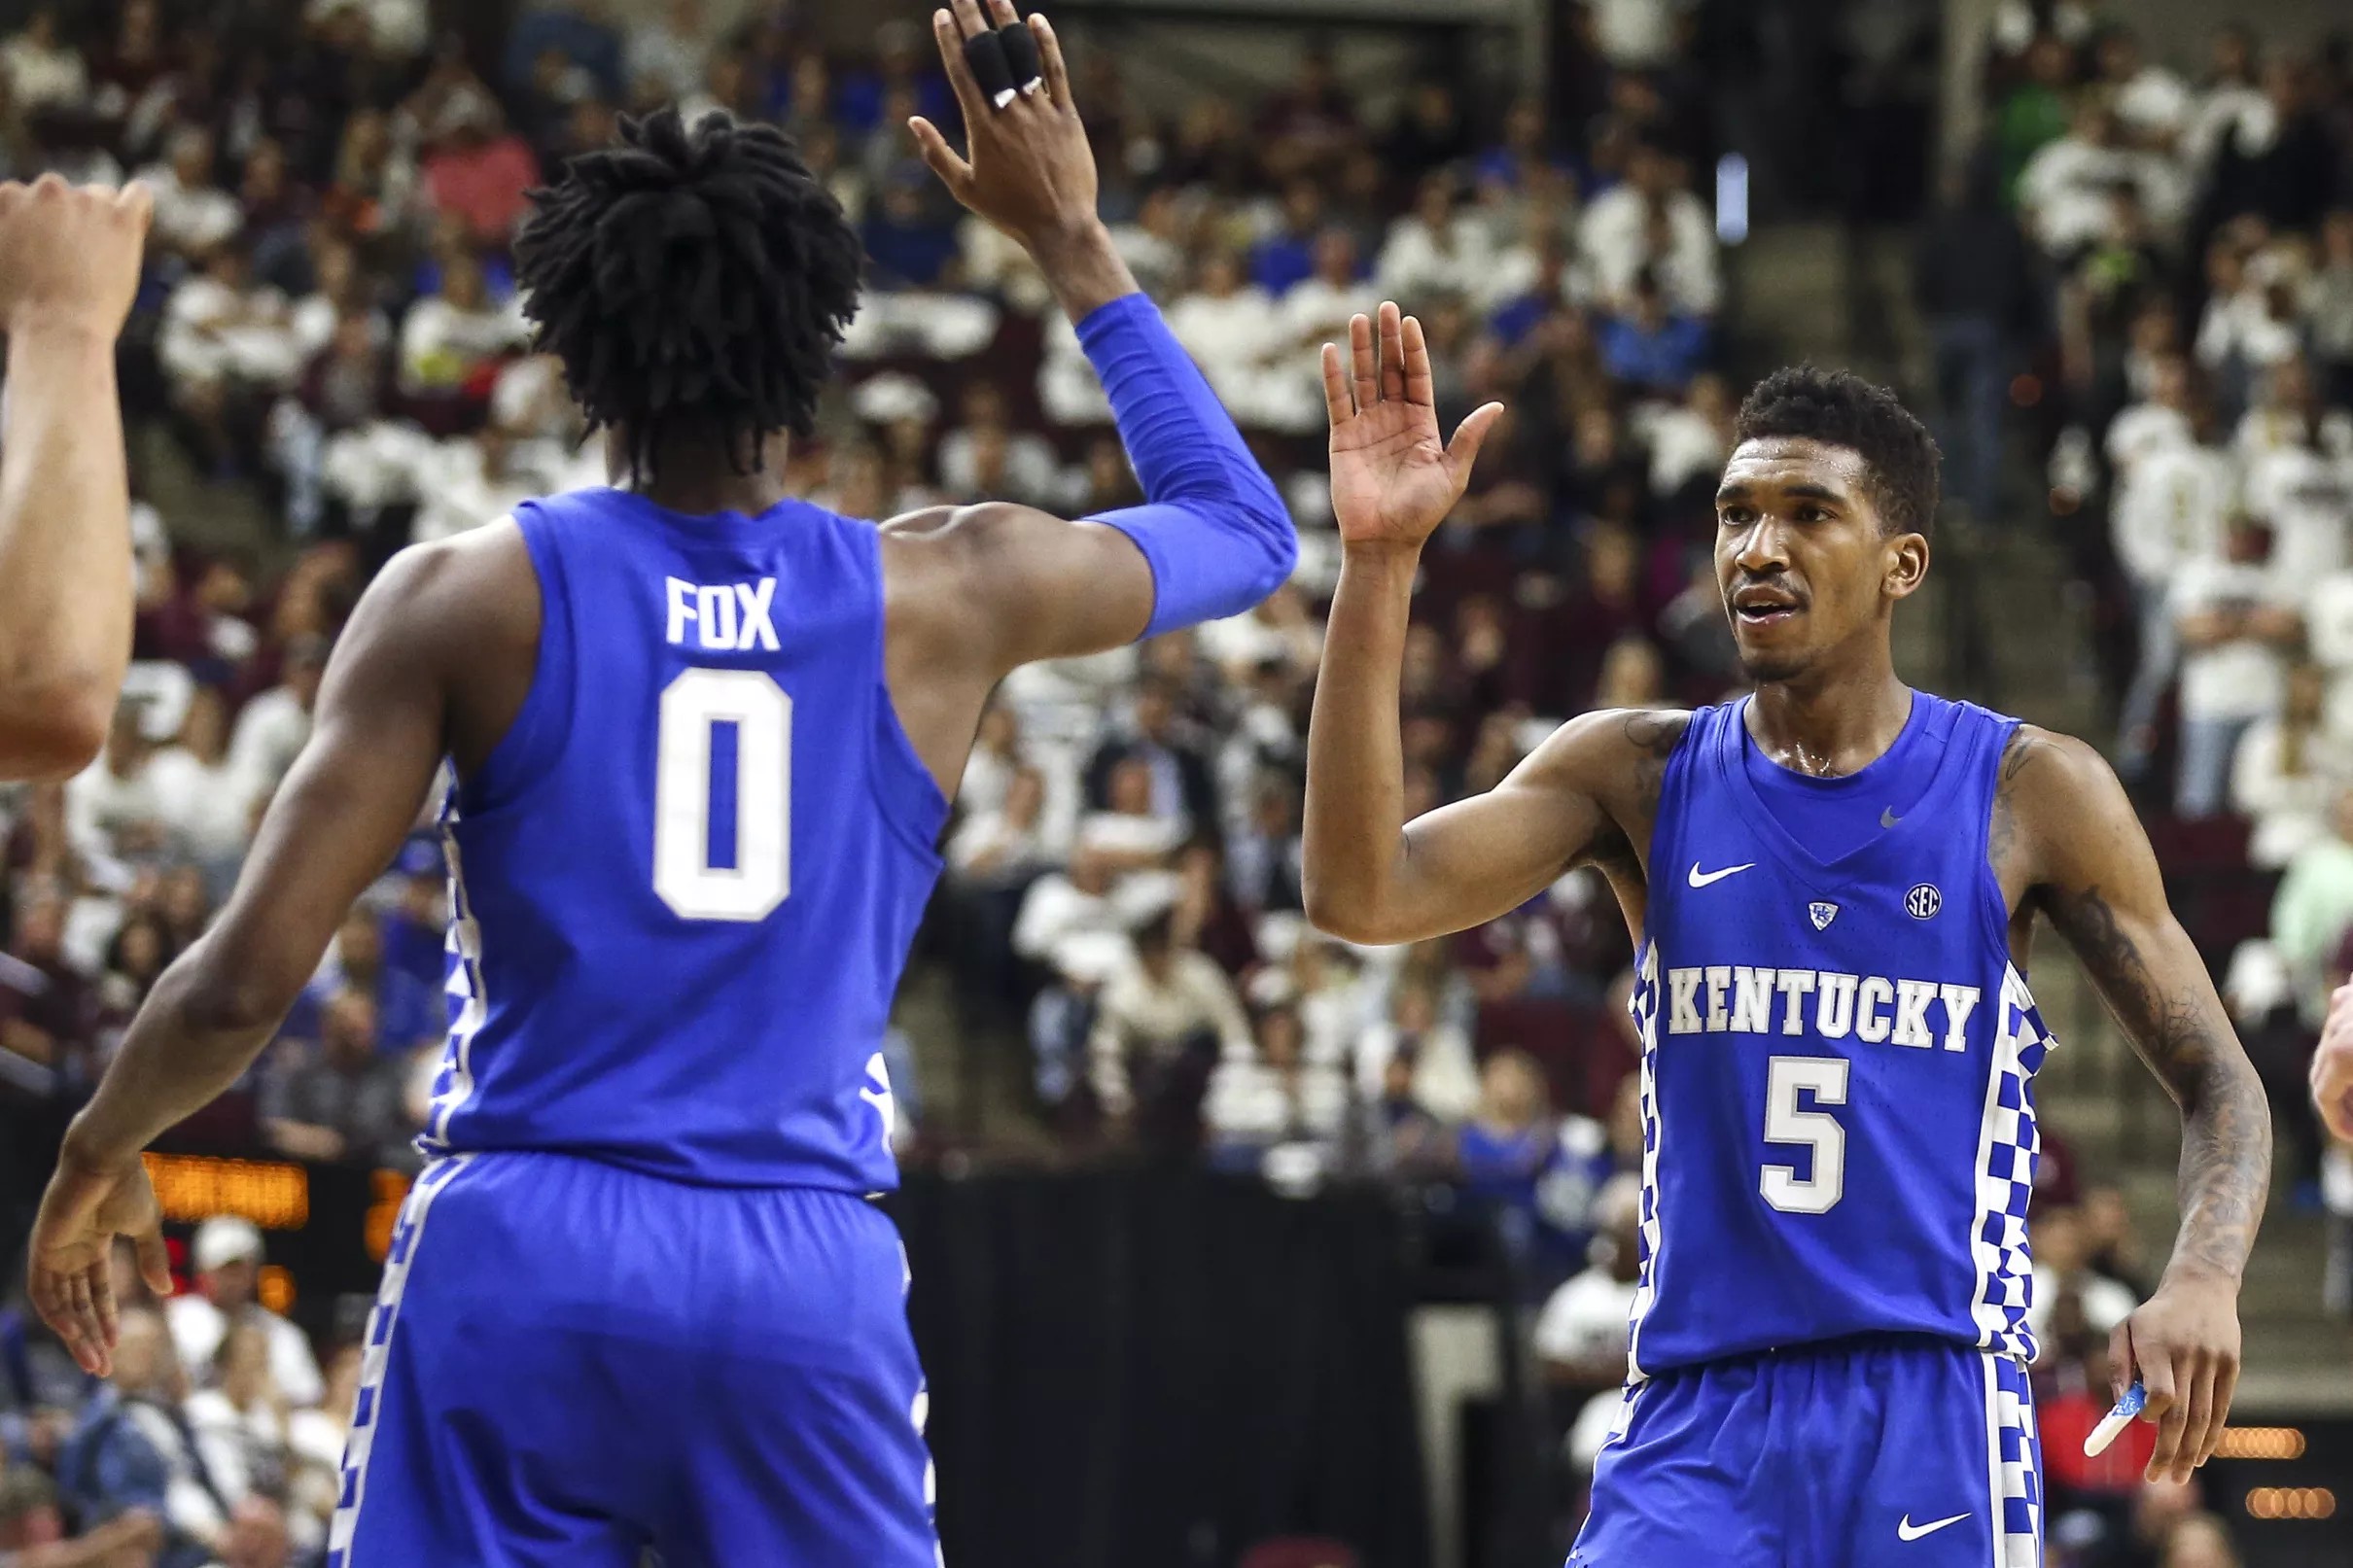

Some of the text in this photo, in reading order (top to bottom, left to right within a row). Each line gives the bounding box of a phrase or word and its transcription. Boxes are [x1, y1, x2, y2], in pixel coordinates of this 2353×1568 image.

[665, 575, 781, 651] FOX
[652, 666, 792, 922] 0
[1908, 887, 1939, 917] SEC
[1668, 965, 1981, 1052] KENTUCKY
[1759, 1056, 1849, 1214] 5
